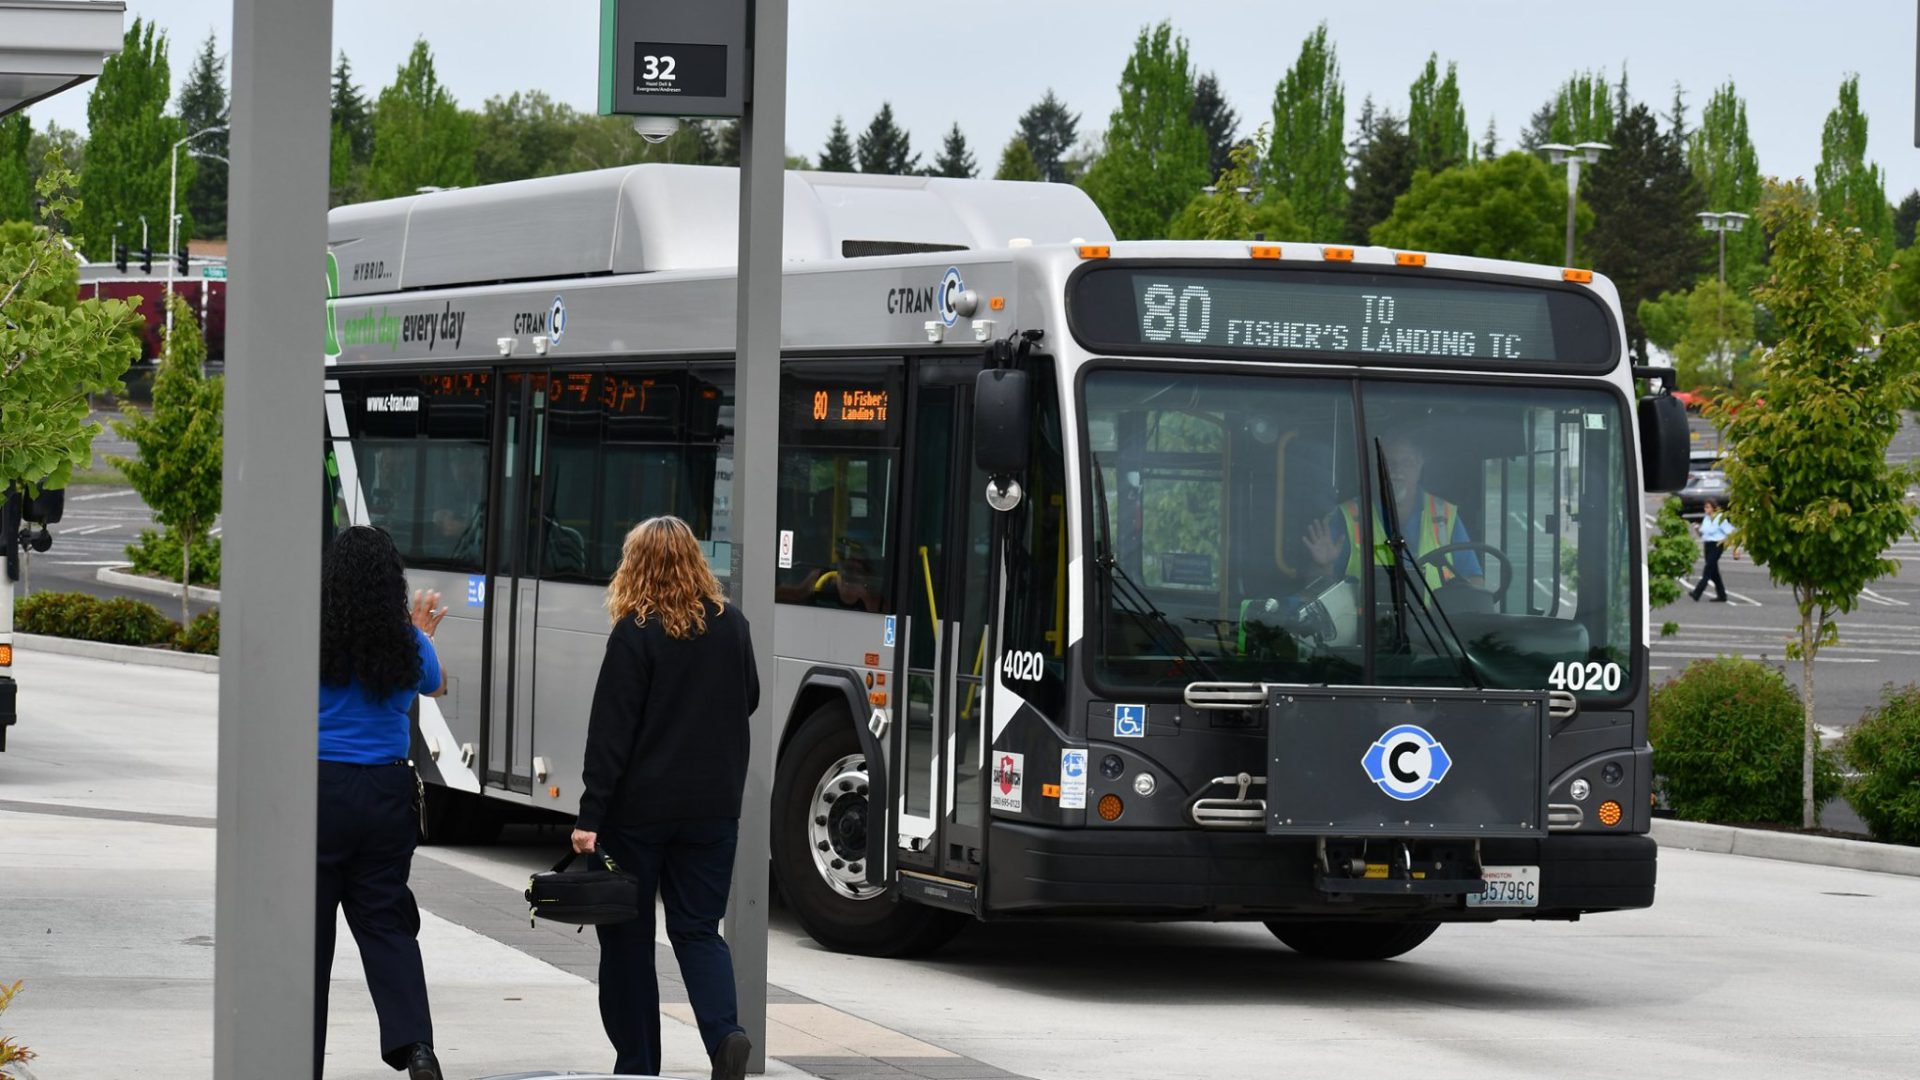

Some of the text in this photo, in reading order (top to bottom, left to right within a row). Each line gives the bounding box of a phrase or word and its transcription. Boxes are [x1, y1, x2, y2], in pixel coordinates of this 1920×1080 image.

[643, 55, 676, 80] 32
[1143, 284, 1211, 343] 80
[1362, 295, 1395, 325] TO
[378, 305, 401, 353] day
[402, 307, 439, 352] every
[441, 301, 466, 350] day
[1228, 319, 1522, 359] FISHER'S LANDING TC
[366, 394, 419, 412] www.c-tran.com
[814, 391, 828, 420] 80
[842, 407, 875, 420] Landing
[843, 391, 853, 406] to
[1003, 649, 1044, 682] 4020
[1548, 661, 1622, 692] 4020
[1388, 741, 1421, 784] C
